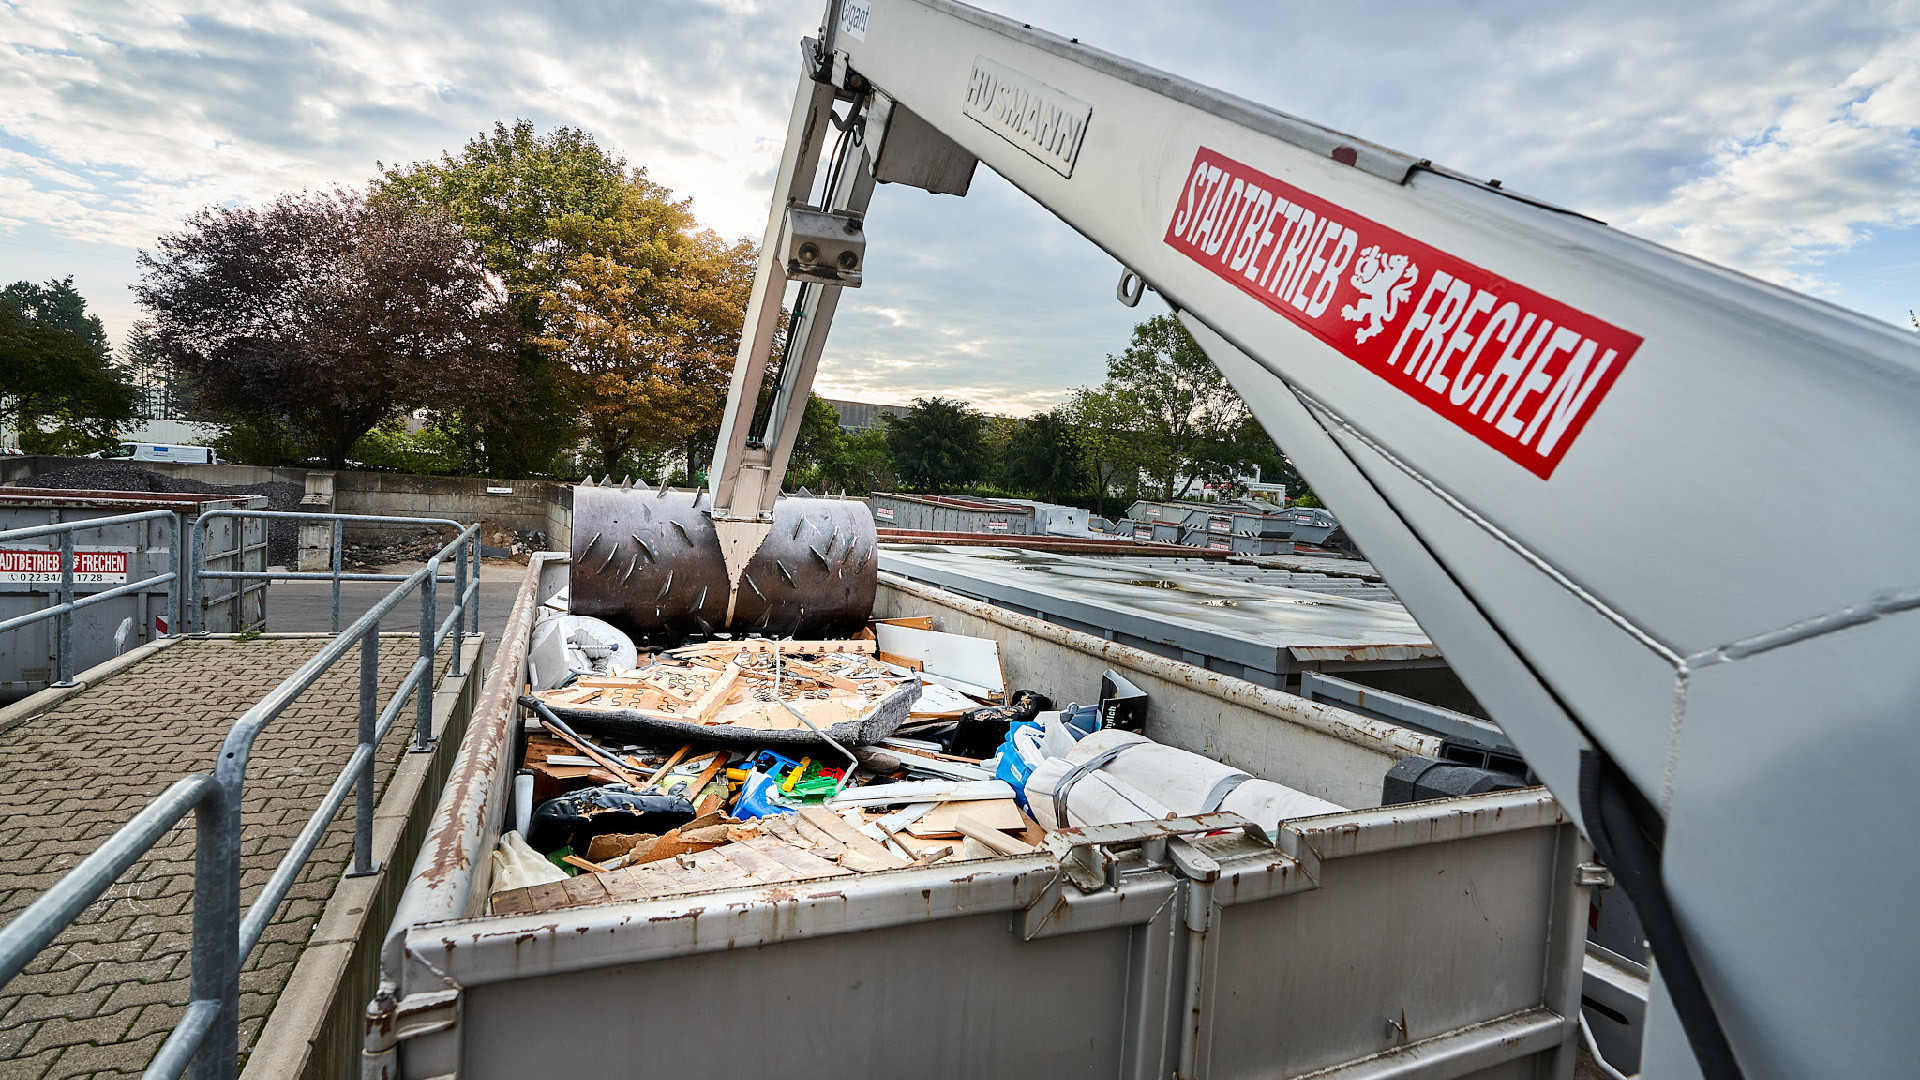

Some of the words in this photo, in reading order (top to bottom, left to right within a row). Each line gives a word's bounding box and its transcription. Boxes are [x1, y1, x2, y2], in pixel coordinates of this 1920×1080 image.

[967, 67, 1083, 163] HUSMANN
[1174, 161, 1359, 319] STADTBETRIEB
[1386, 269, 1617, 458] FRECHEN
[81, 554, 124, 572] FRECHEN
